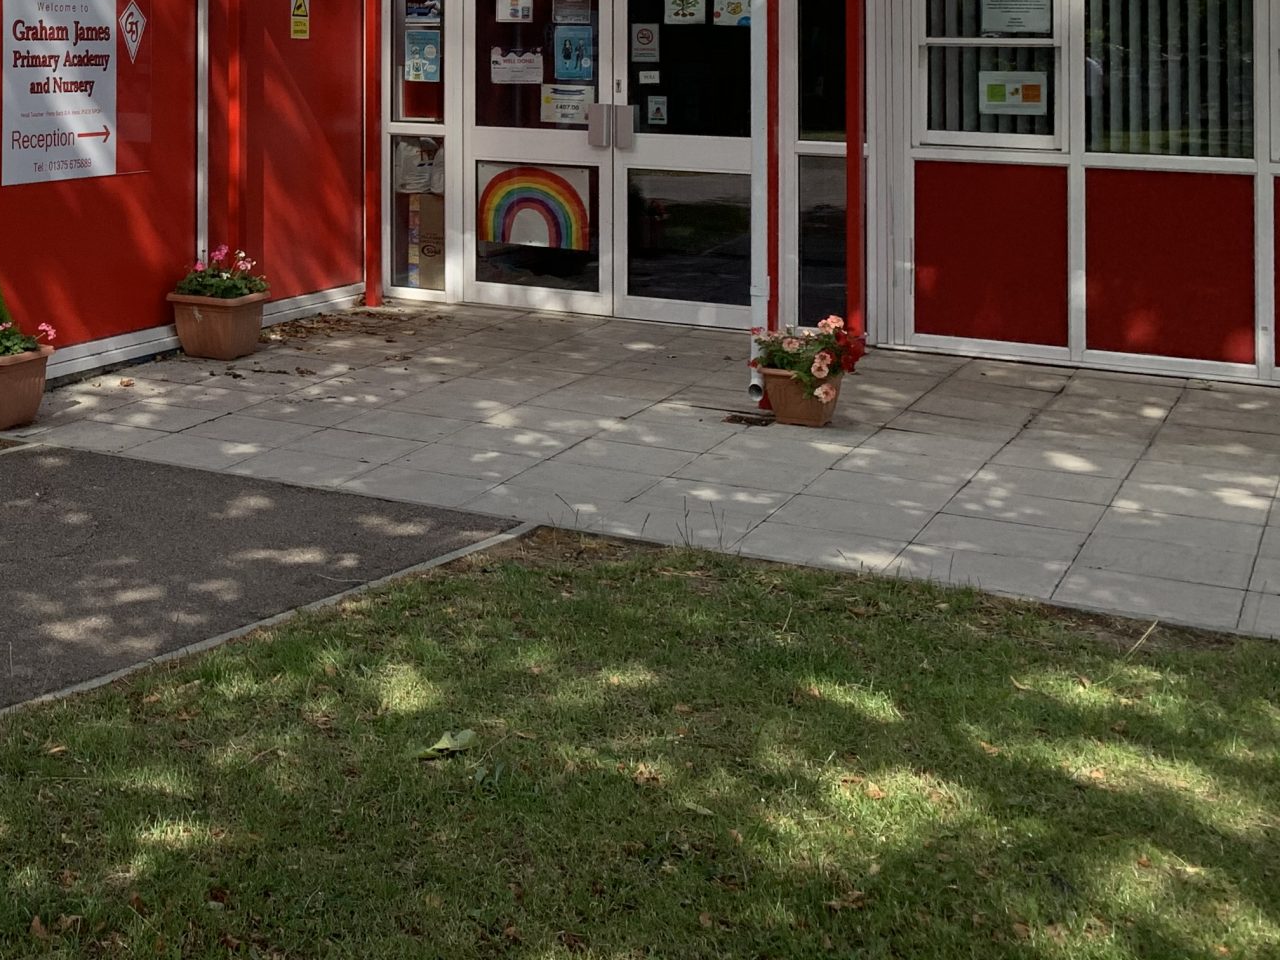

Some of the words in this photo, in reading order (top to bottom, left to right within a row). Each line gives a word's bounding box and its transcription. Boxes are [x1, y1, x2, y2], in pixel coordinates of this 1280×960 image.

[37, 1, 77, 13] Welcome
[80, 4, 89, 13] to
[12, 19, 69, 41] Graham
[72, 20, 111, 46] James
[12, 50, 60, 73] Primary
[63, 49, 110, 72] Academy
[29, 76, 50, 95] and
[52, 76, 95, 97] Nursery
[11, 128, 75, 152] Reception
[33, 161, 44, 172] Tel
[48, 160, 69, 172] 01375
